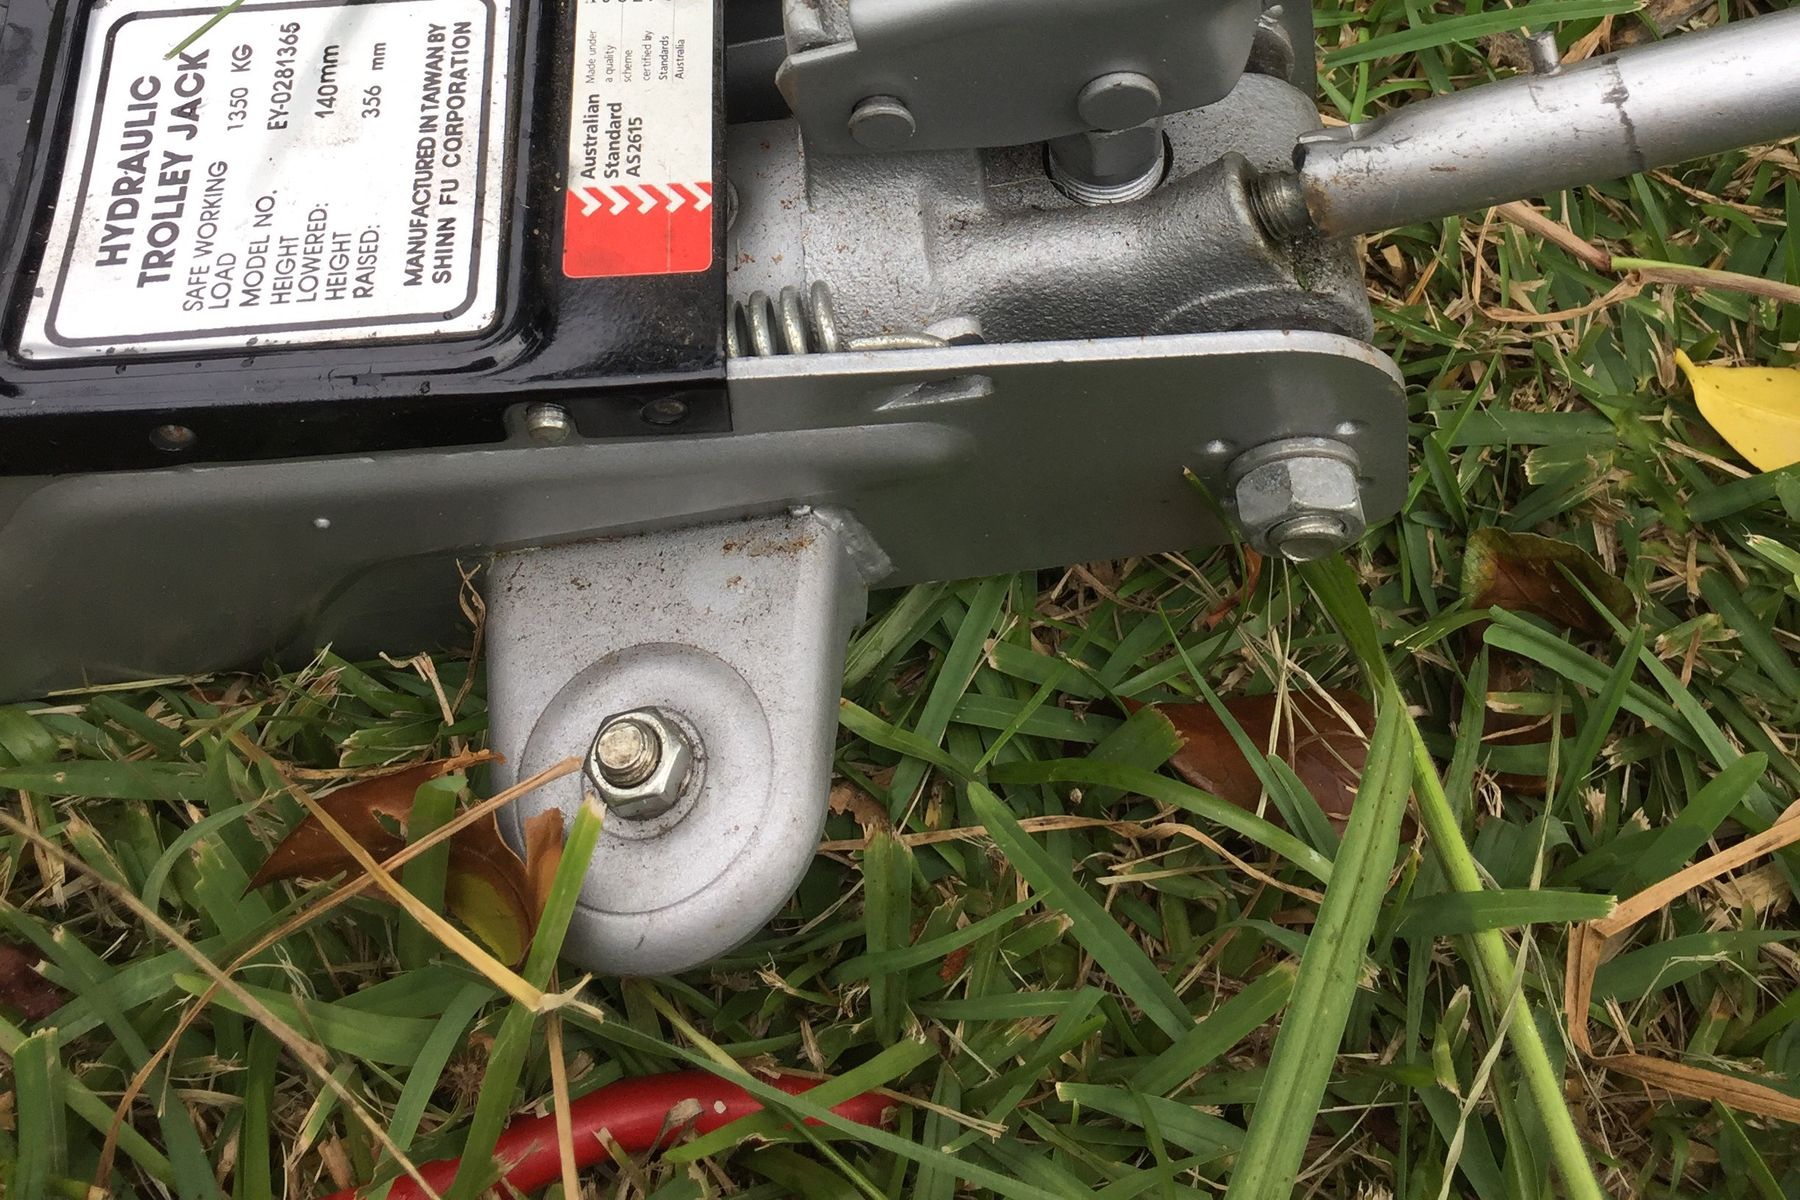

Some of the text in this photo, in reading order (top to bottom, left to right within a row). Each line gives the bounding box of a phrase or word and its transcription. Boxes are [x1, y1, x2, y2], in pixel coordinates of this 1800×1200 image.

[227, 44, 253, 131] 1350 KG
[314, 45, 340, 119] 140mm
[361, 42, 386, 119] 356 mm
[585, 30, 597, 84] Made under
[604, 44, 617, 75] quality
[622, 50, 633, 83] scheme
[642, 44, 653, 81] certified
[658, 35, 669, 81] Standards
[674, 39, 686, 80] Australia
[95, 75, 161, 267] HYDRAULIC
[136, 49, 210, 288] TROLLEY JACK
[239, 22, 301, 307] MODEL NO. EY-0281365
[403, 23, 446, 286] MANUFACTURED IN TAIWAN BY
[432, 21, 472, 284] SHINN FU CORPORATION
[580, 93, 600, 180] Australian
[603, 102, 622, 179] Standard
[625, 116, 643, 178] AS2615
[182, 160, 228, 311] SAFE WORKING
[270, 235, 299, 305] HEIGHT
[296, 203, 329, 303] LOWERED:
[324, 232, 352, 300] HEIGHT
[352, 224, 380, 299] RAISED:
[208, 253, 236, 309] LOAD
